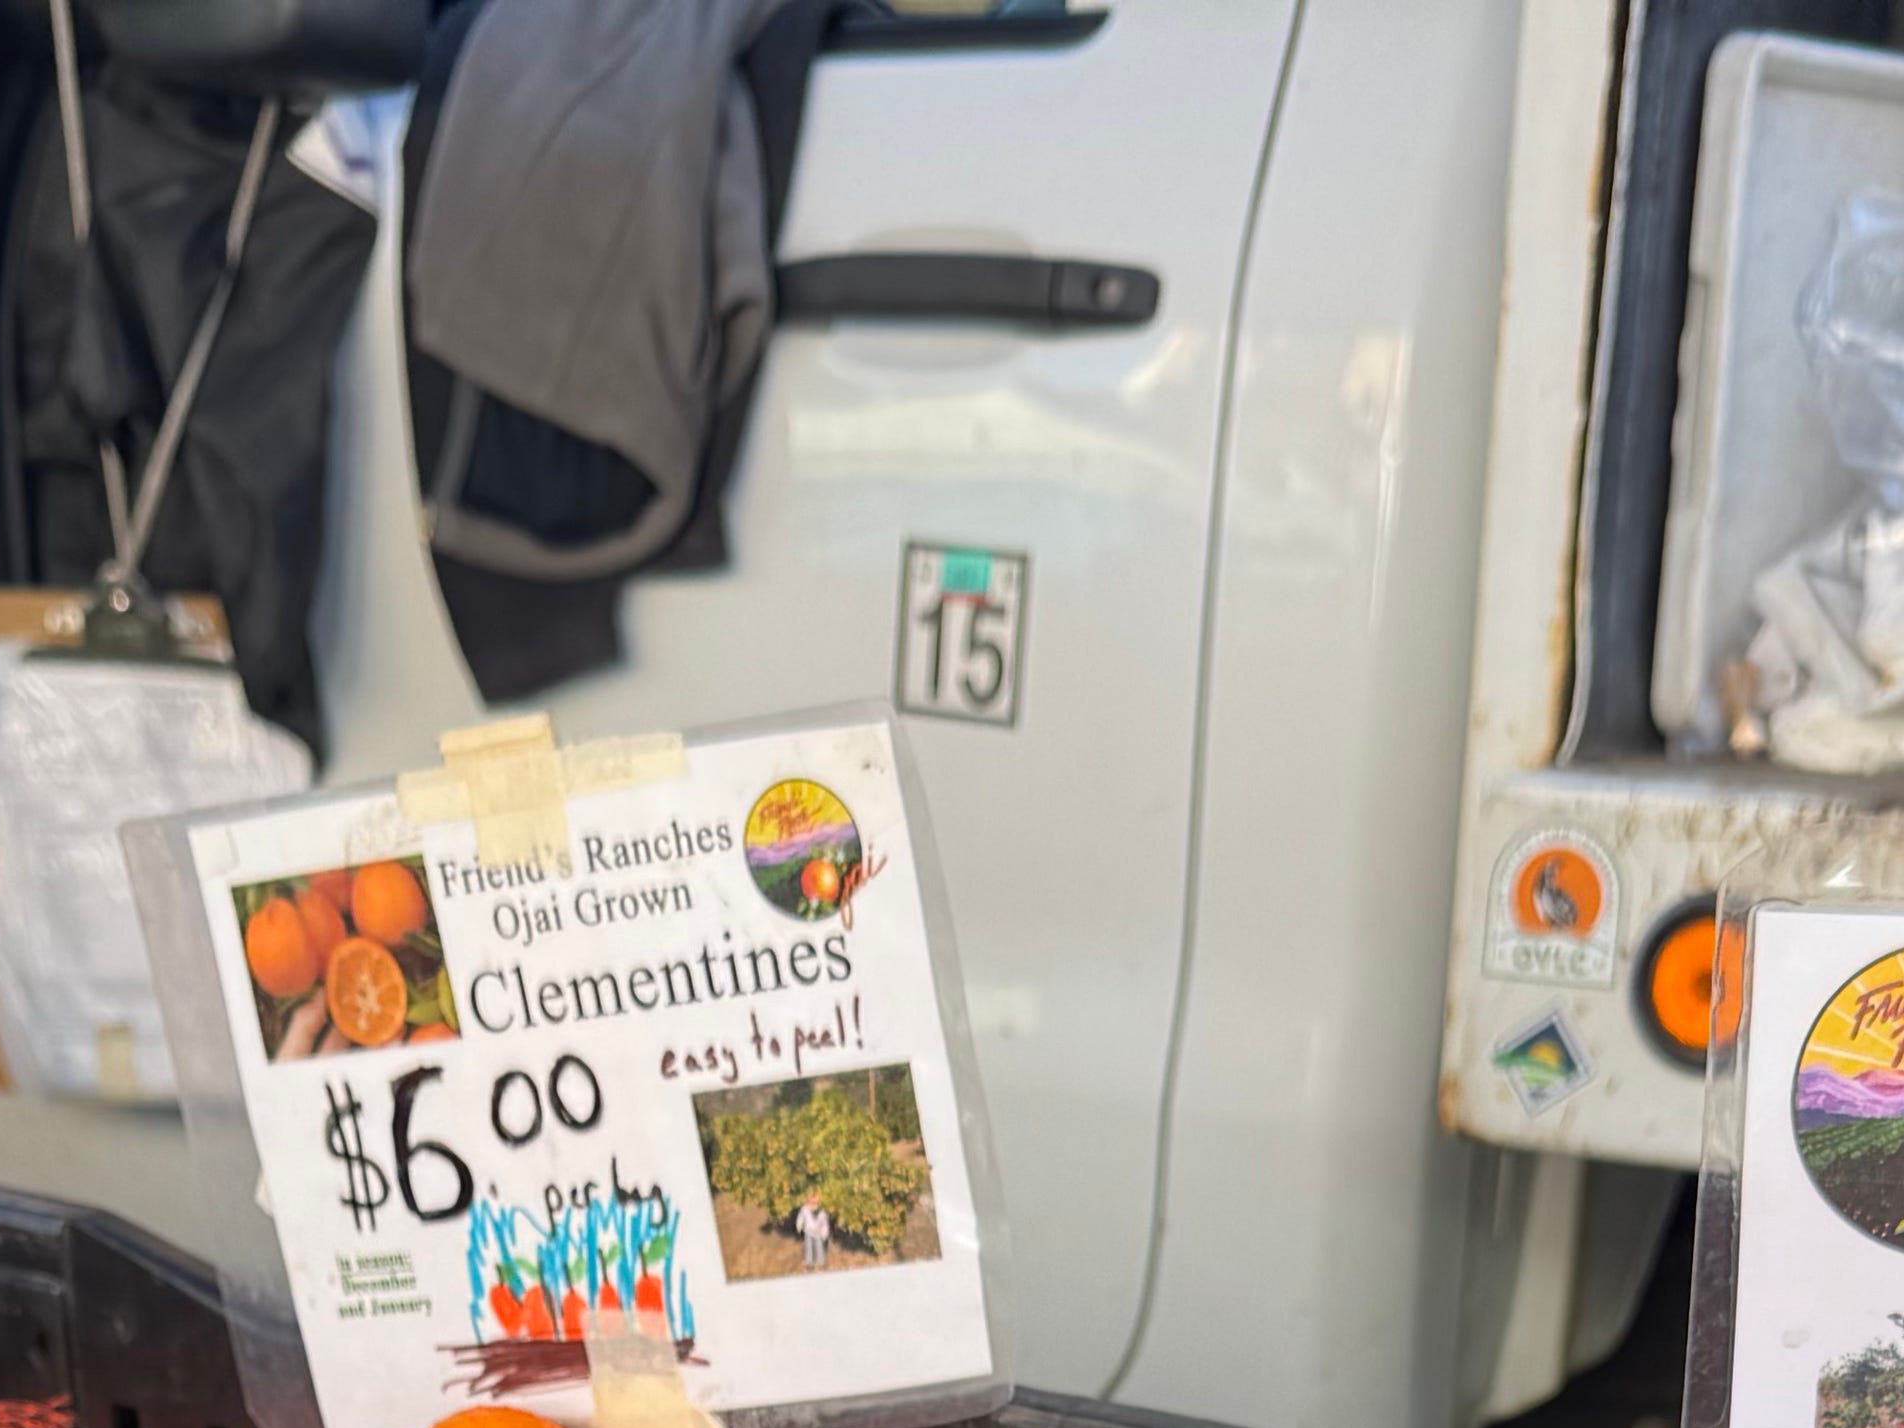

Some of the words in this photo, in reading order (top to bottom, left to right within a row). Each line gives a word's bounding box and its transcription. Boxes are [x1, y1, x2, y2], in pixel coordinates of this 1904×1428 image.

[918, 602, 1006, 707] 15
[438, 845, 574, 898] Friend's
[582, 817, 734, 875] Ranches
[492, 902, 564, 947] Ojai
[573, 880, 695, 928] Grown
[469, 930, 853, 1034] Clementines
[660, 1046, 739, 1084] easy
[750, 1011, 781, 1062] to
[794, 995, 865, 1074] peel!
